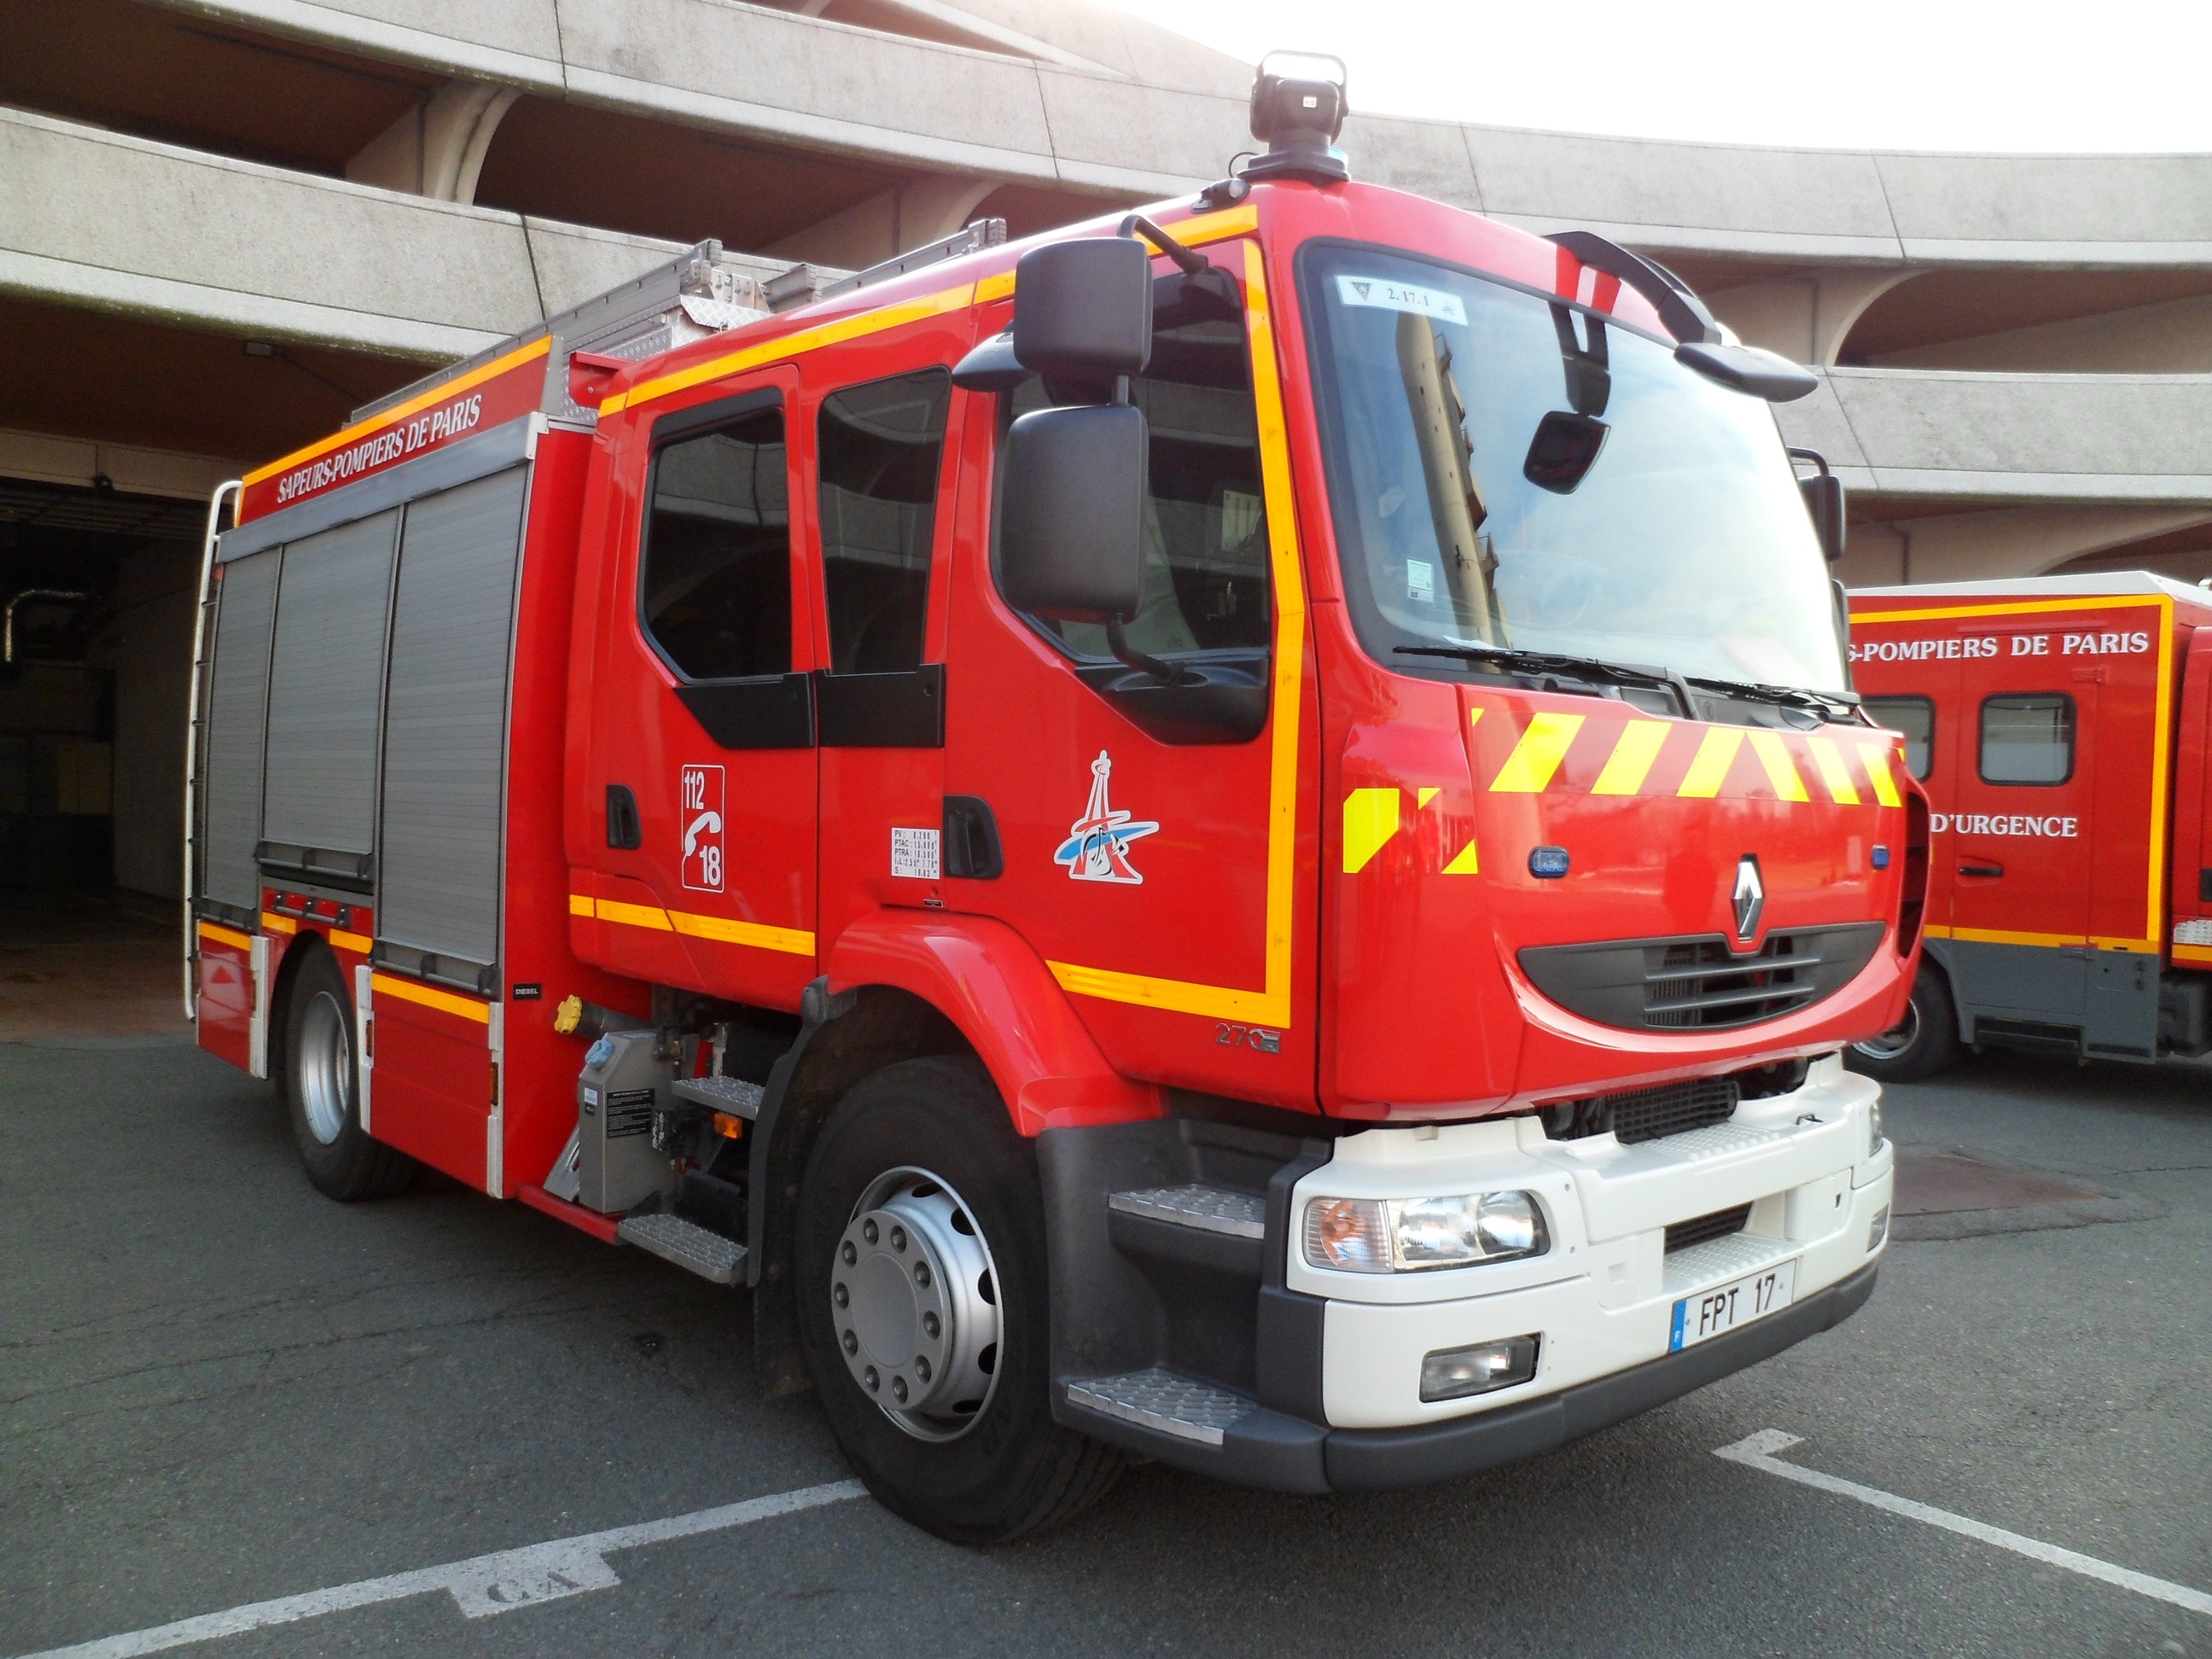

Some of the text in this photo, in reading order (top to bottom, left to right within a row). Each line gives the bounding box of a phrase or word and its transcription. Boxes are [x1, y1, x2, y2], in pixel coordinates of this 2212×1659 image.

[277, 394, 482, 504] SAPEURS-POMPIERS DE PARIS
[2010, 636, 2049, 656] DE
[2061, 632, 2150, 655] PARIS
[684, 771, 705, 810] 112
[1930, 813, 2078, 837] D'URGENCE
[699, 845, 721, 886] 18
[1699, 1272, 1776, 1336] FPT 17
